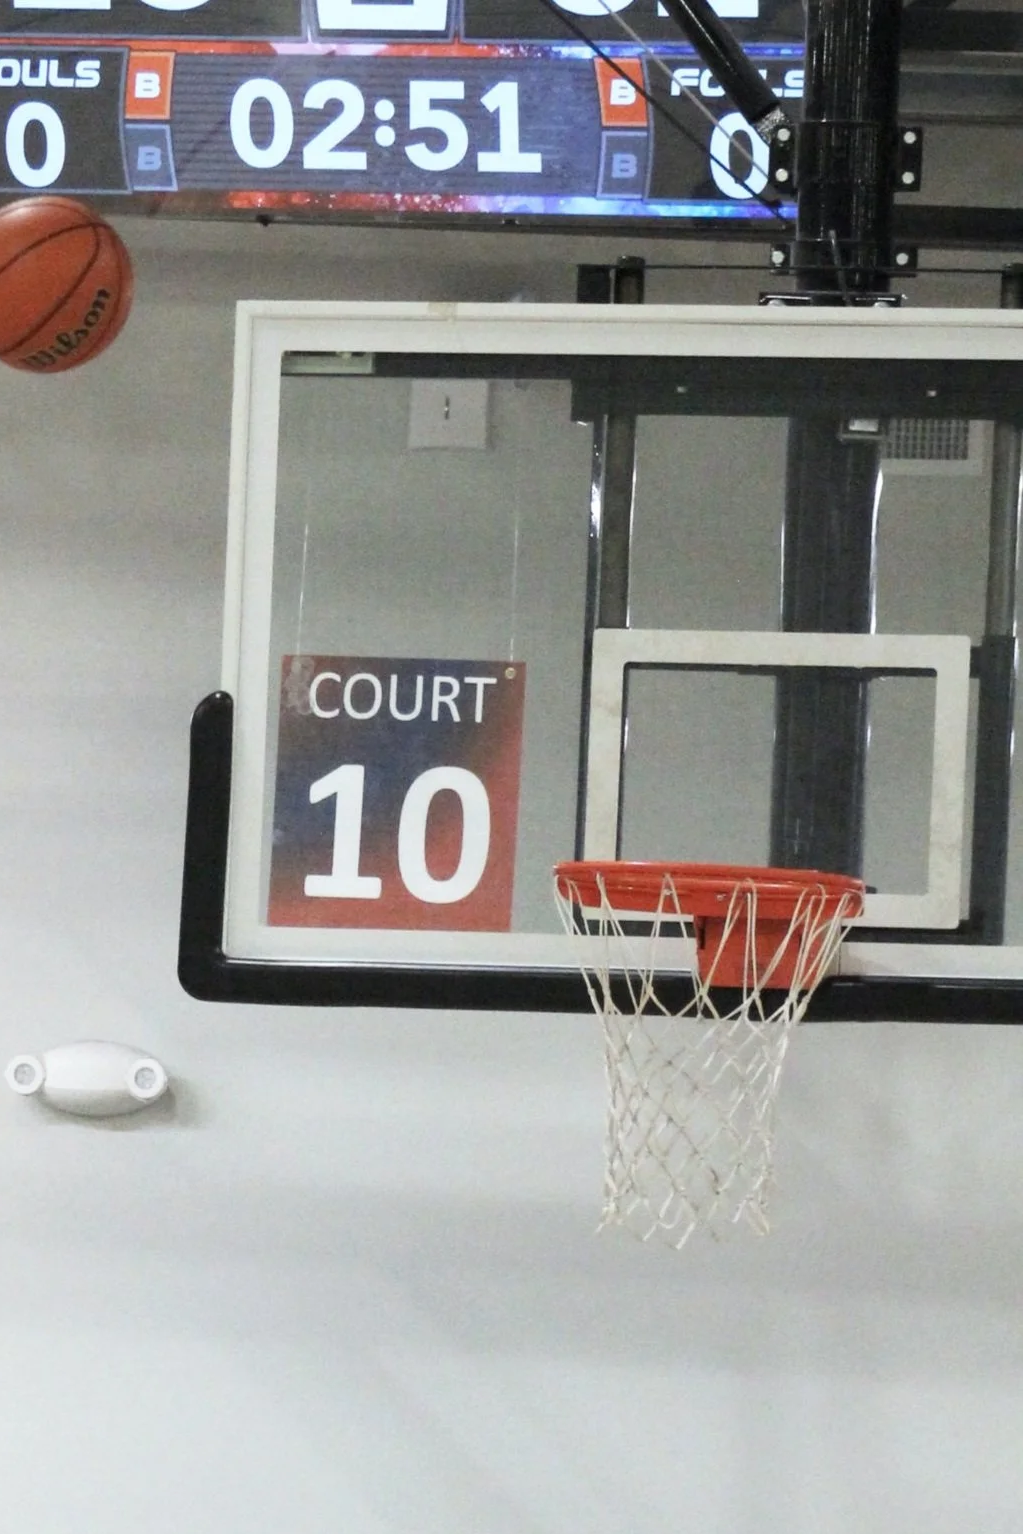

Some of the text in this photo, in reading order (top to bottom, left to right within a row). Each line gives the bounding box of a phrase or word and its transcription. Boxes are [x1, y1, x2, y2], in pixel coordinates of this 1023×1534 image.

[134, 72, 161, 98] B
[229, 78, 542, 174] 02:51
[609, 78, 637, 105] B
[5, 101, 66, 188] 0
[709, 112, 770, 199] 0
[308, 671, 498, 723] COURT
[304, 763, 491, 904] 10
